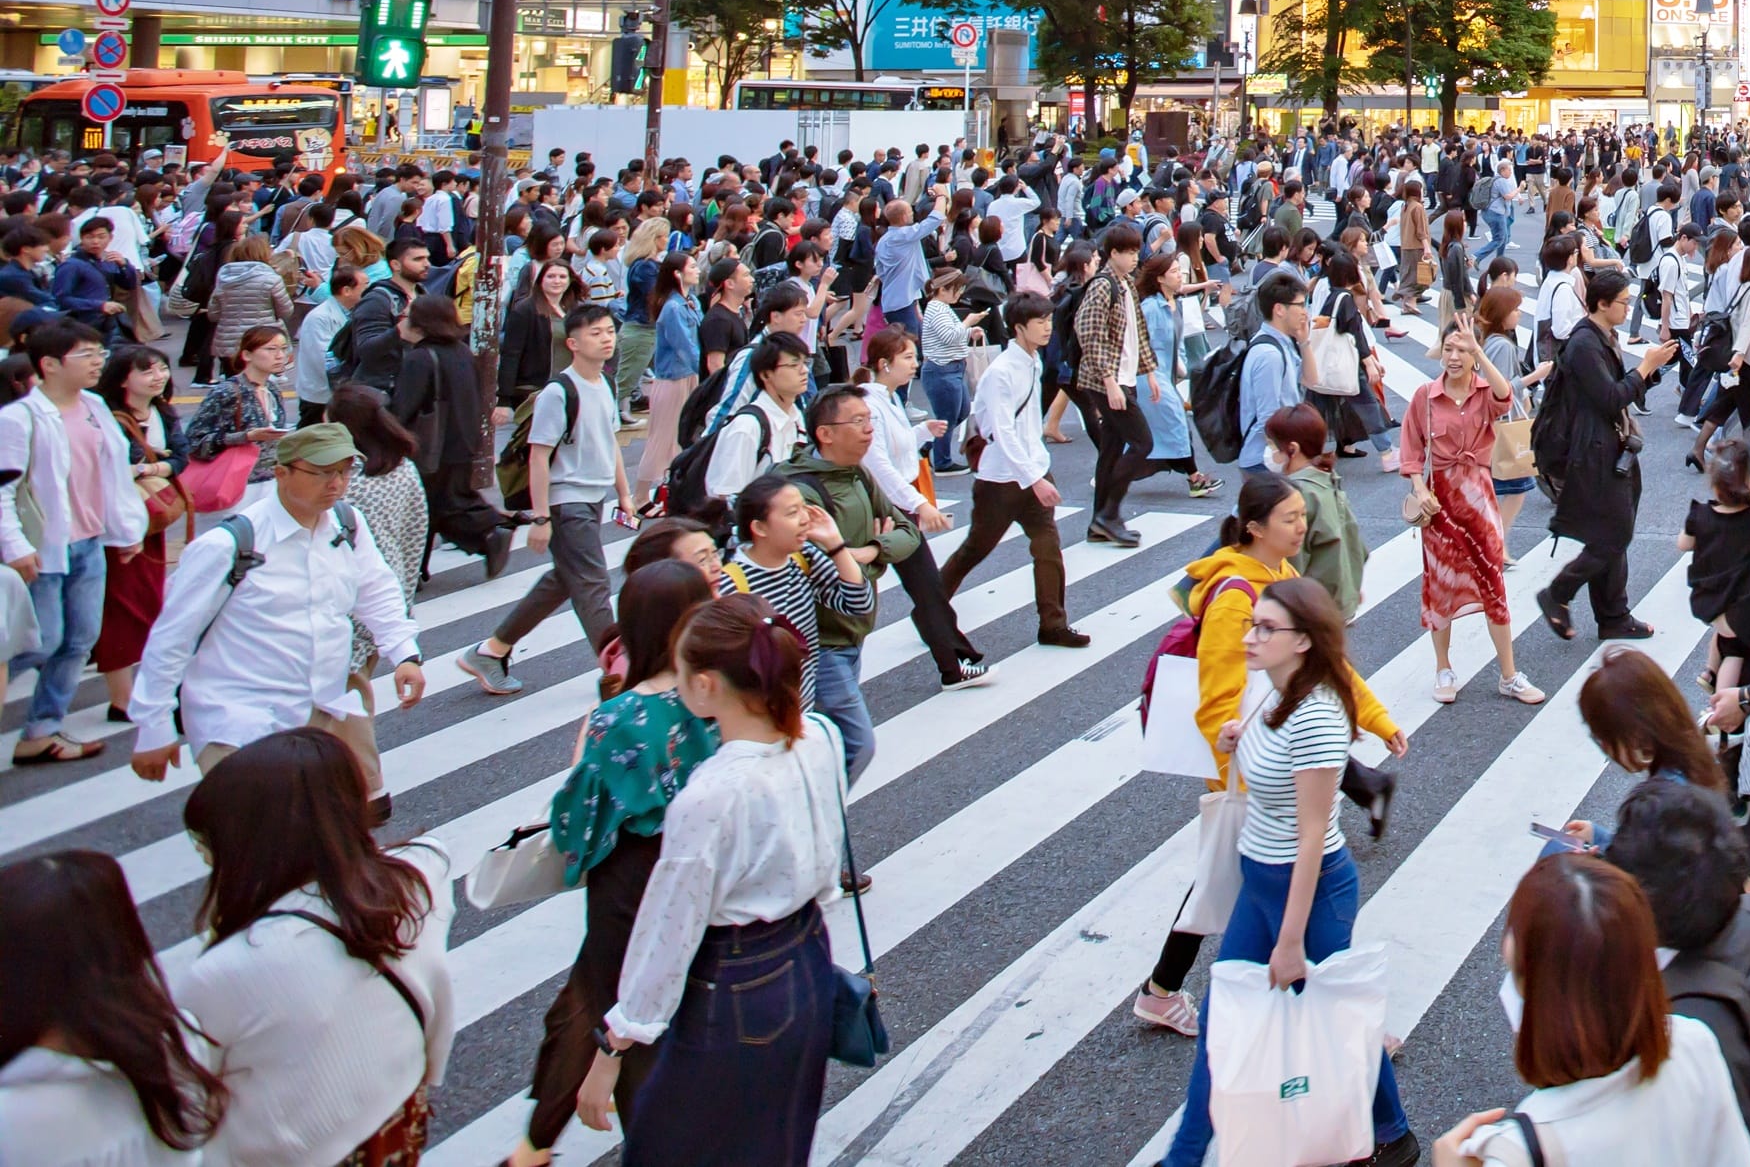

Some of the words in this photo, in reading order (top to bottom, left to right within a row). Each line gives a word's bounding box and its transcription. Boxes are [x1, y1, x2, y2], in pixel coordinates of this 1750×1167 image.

[1657, 9, 1682, 21] ON
[195, 35, 252, 45] SHIBUYA
[255, 35, 294, 45] MARK
[296, 35, 329, 45] CITY
